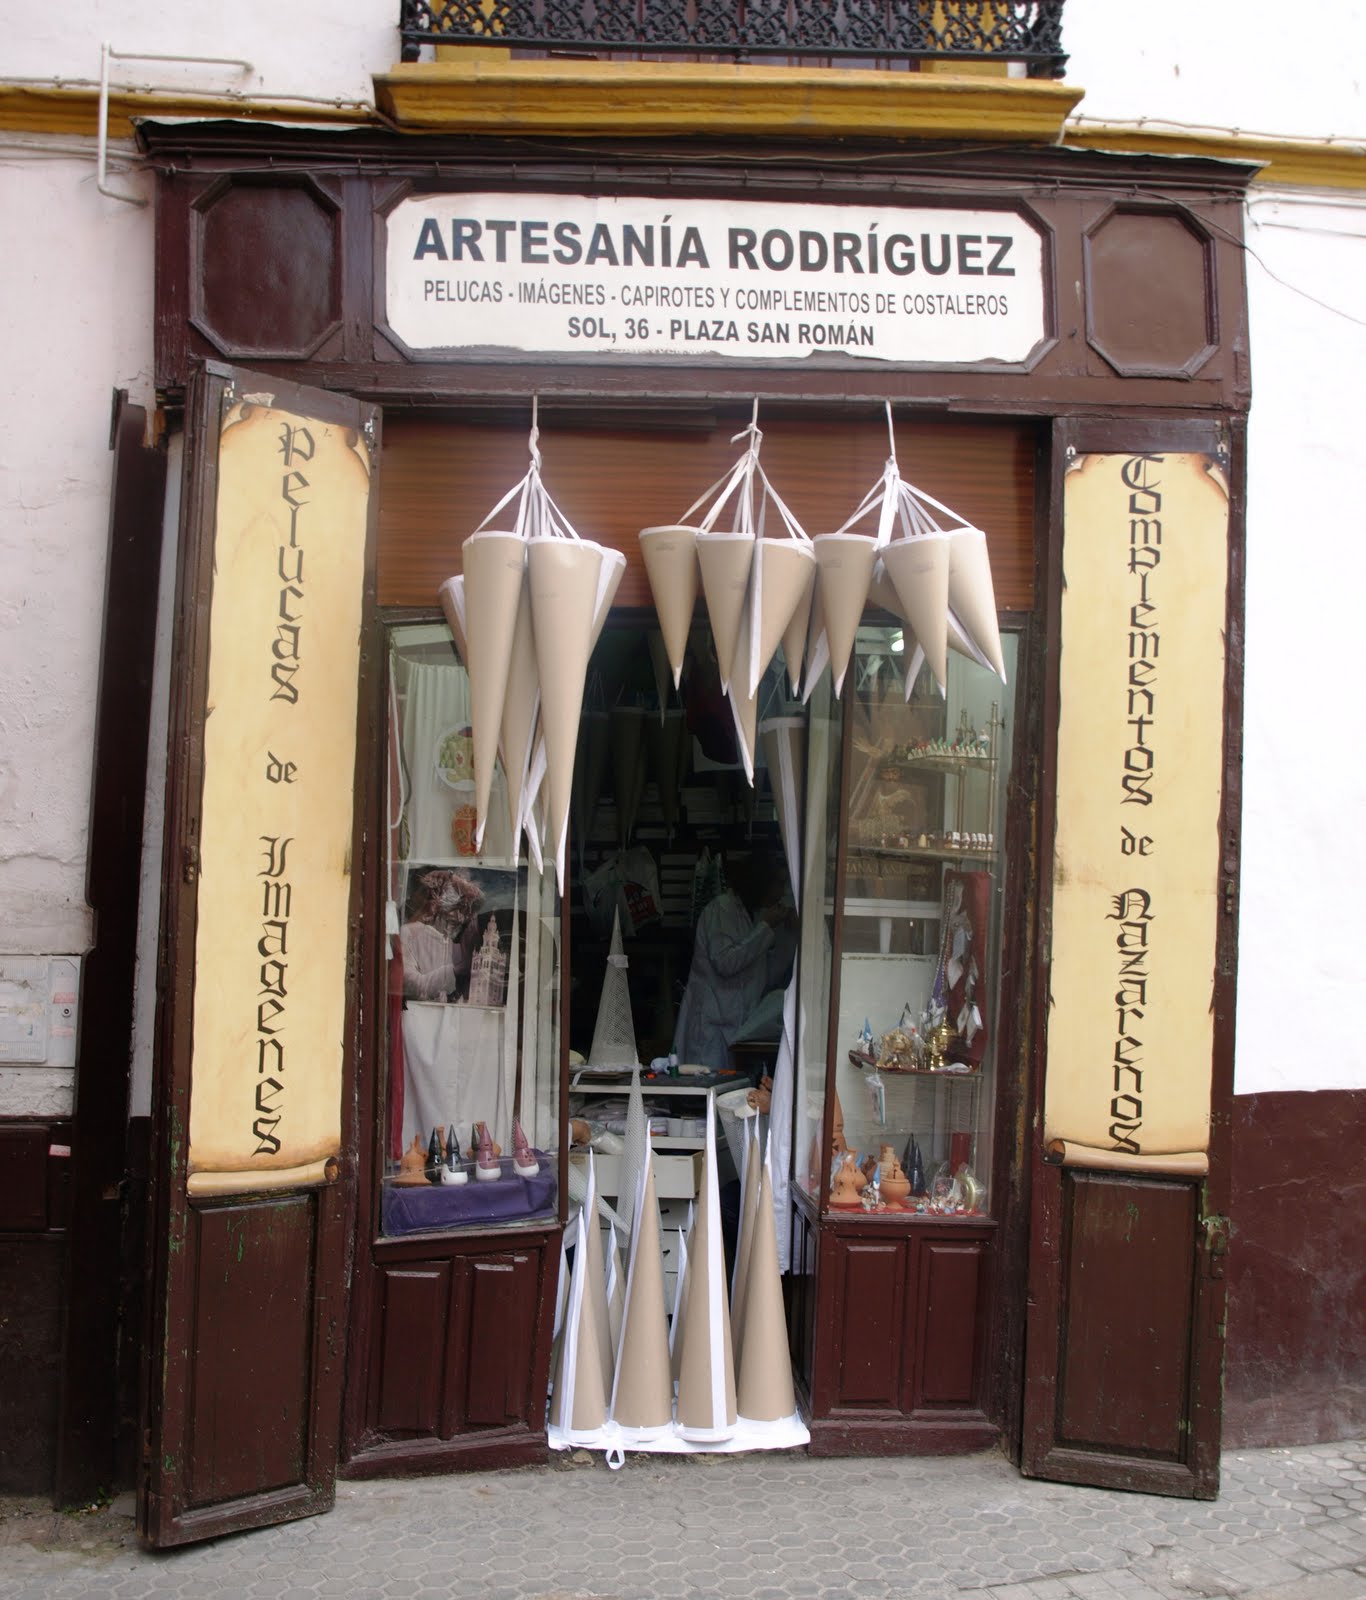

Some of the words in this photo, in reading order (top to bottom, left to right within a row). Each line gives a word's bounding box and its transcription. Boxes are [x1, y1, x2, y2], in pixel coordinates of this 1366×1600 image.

[413, 214, 710, 268] ARTESANÍA
[728, 222, 1016, 277] RODRÍGUEZ
[424, 280, 503, 303] PELUCAS
[518, 277, 605, 306] IMÁGENES
[621, 285, 715, 308] CAPIROTES
[720, 287, 730, 308] Y
[735, 288, 870, 314] COMPLEMENTOS
[875, 293, 897, 314] DE
[903, 294, 1008, 316] COSTALEROS
[568, 316, 617, 344] SOL,
[625, 318, 649, 339] 36
[670, 319, 740, 341] PLAZA
[747, 322, 790, 343] SAN
[798, 320, 874, 346] ROMÁN
[269, 422, 315, 705] Pelucas
[1119, 455, 1165, 806] Complementos
[266, 750, 298, 785] de
[1120, 825, 1154, 857] de
[1104, 887, 1155, 1156] Nazarenos
